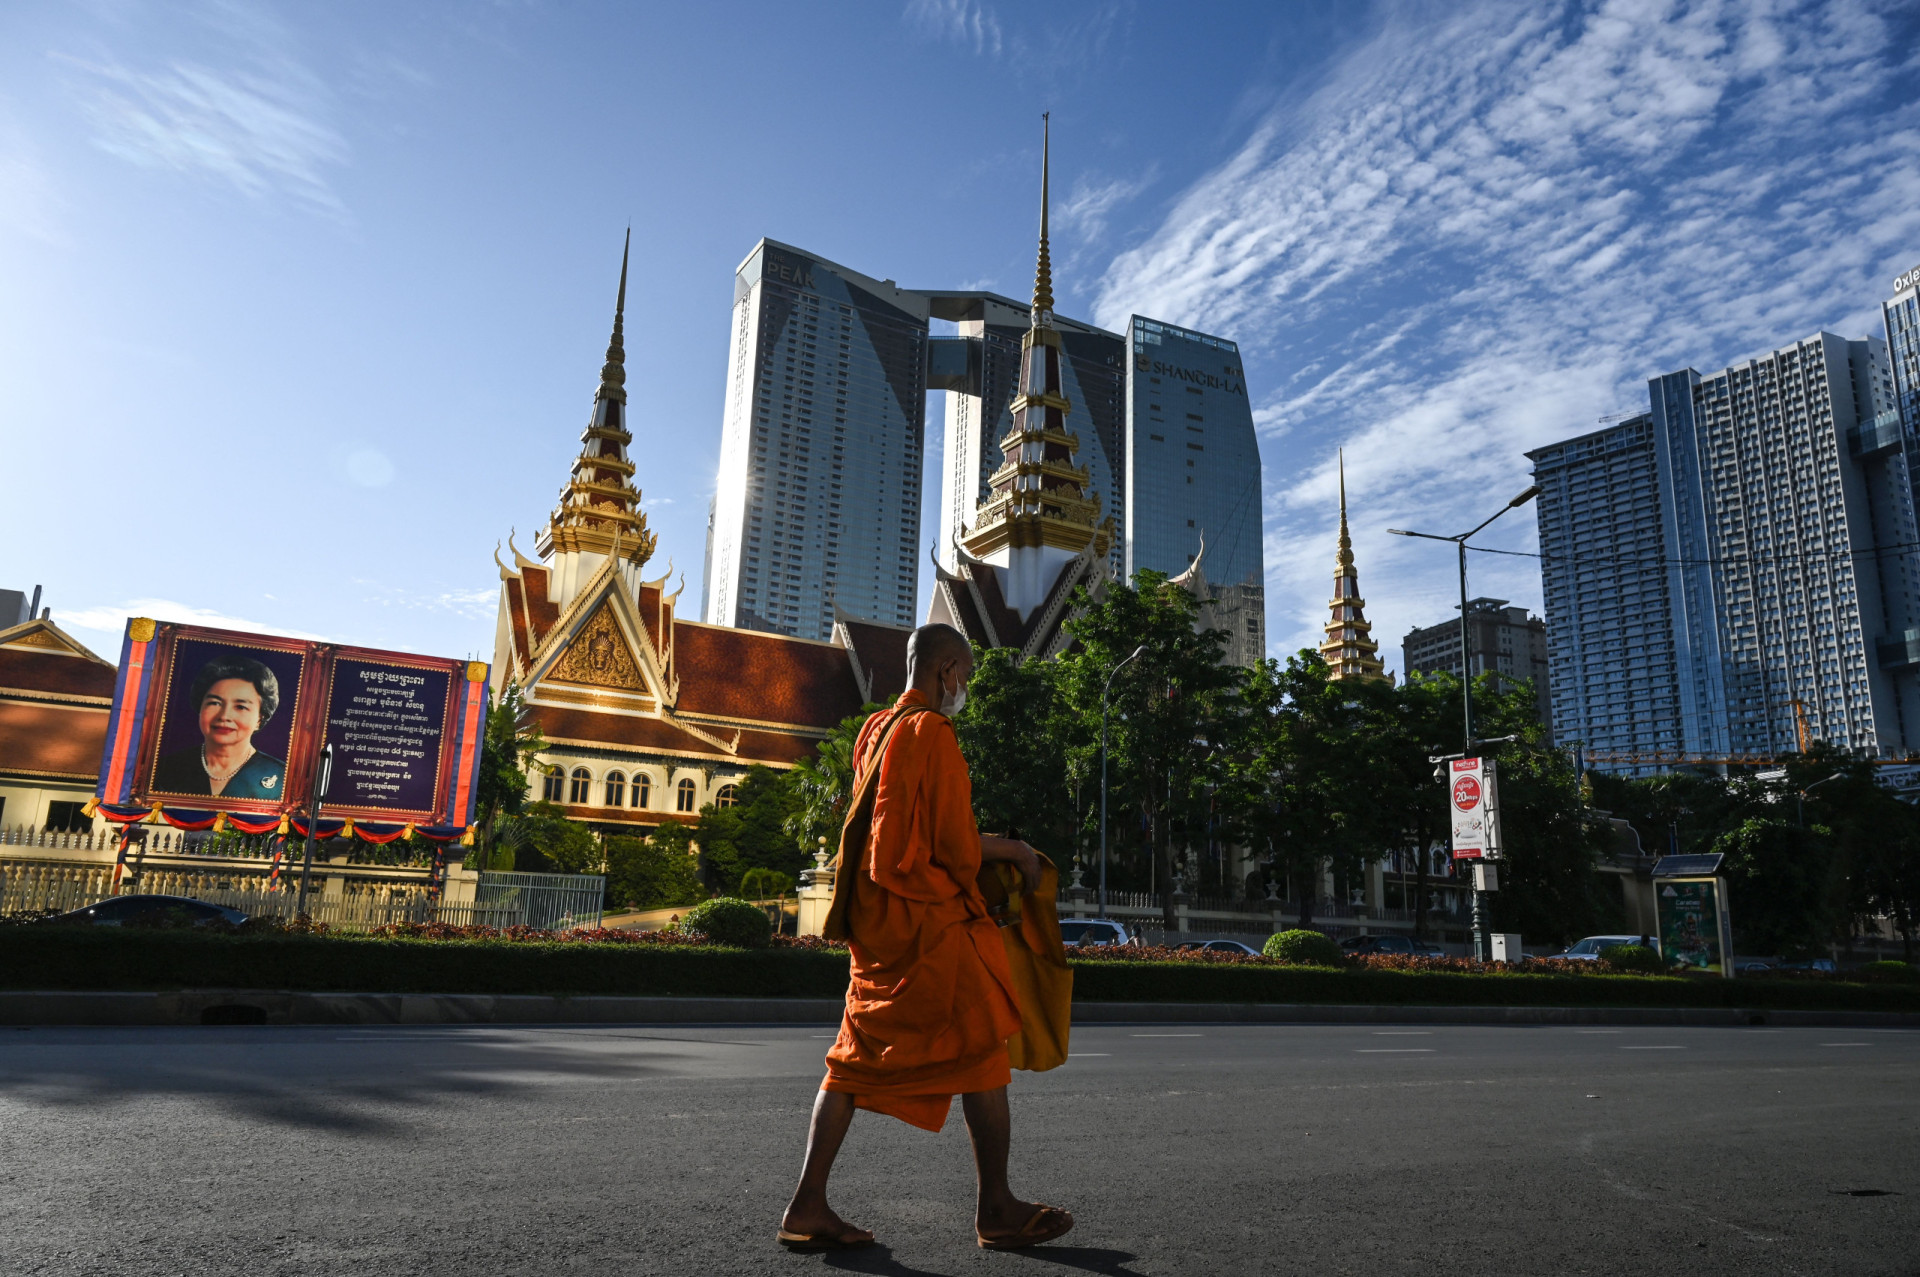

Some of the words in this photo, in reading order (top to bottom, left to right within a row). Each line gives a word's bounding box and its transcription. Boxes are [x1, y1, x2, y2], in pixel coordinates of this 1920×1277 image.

[770, 254, 785, 262] THE
[767, 262, 816, 289] PEAK
[1894, 268, 1920, 292] Oxle
[1153, 360, 1242, 396] SHANGRI-LA
